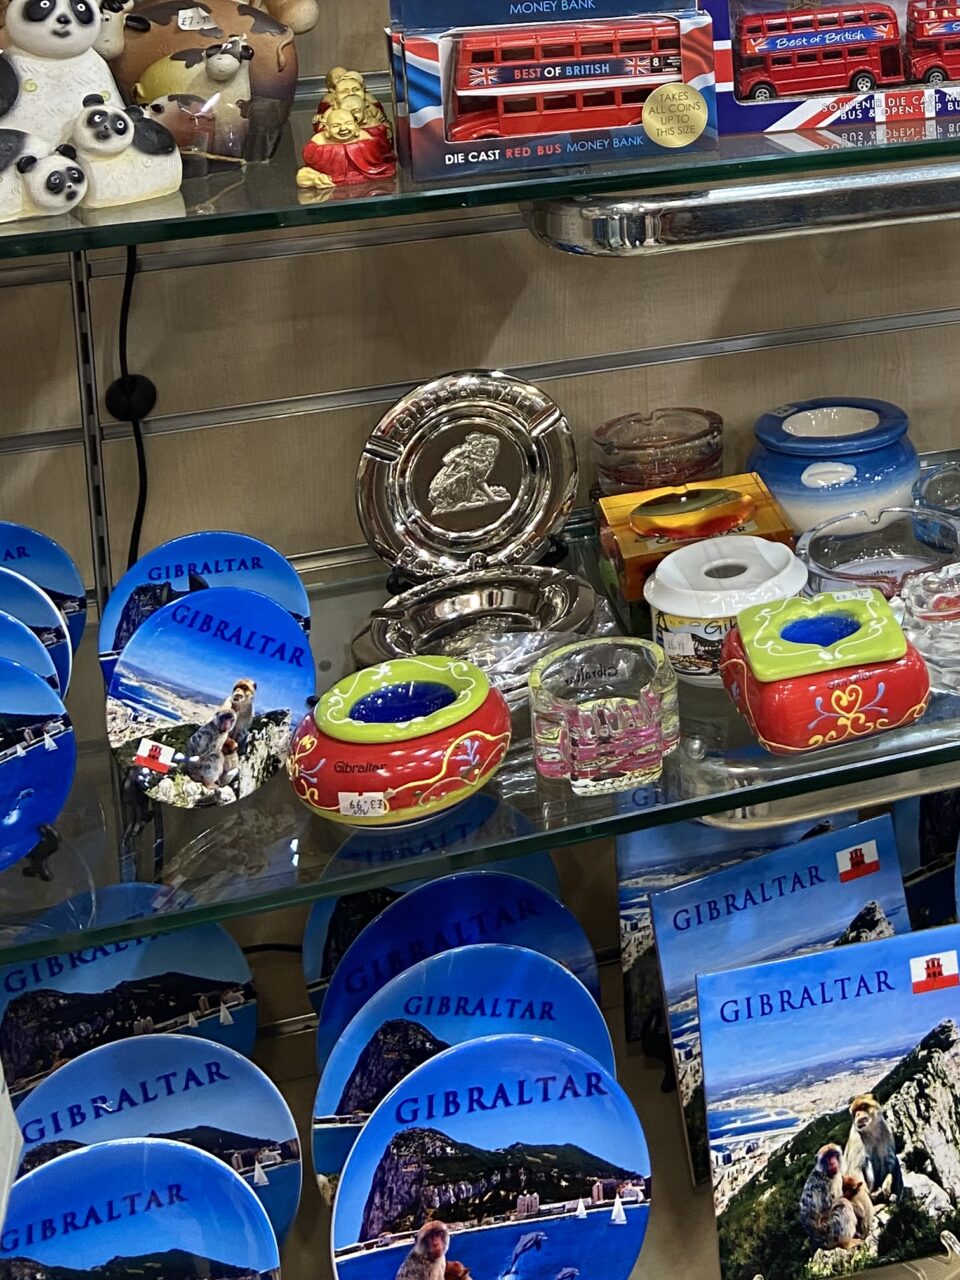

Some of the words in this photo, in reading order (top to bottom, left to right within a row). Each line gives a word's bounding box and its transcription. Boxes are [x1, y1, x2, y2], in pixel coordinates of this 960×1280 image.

[509, 0, 557, 15] MONEY
[776, 36, 808, 49] Best
[810, 35, 822, 45] of
[824, 30, 865, 43] British
[514, 68, 542, 80] BEST
[544, 66, 562, 78] OF
[565, 63, 610, 76] BRITISH
[652, 57, 660, 67] 8
[659, 91, 689, 101] TAKES
[821, 99, 883, 114] SOUVENIR
[889, 96, 907, 107] DIE
[911, 94, 940, 107] CAST
[648, 104, 666, 115] ALL
[668, 101, 701, 113] COINS
[840, 110, 863, 120] BUS
[660, 115, 675, 125] UP
[676, 113, 690, 124] TO
[656, 126, 676, 137] THIS
[677, 124, 697, 135] SIZE
[445, 153, 465, 165] DIE
[468, 150, 500, 163] CAST
[505, 146, 531, 159] RED
[537, 143, 562, 155] BUS
[566, 138, 609, 152] MONEY
[613, 135, 644, 148] BANK
[148, 556, 264, 581] GIBRALTAR
[172, 604, 305, 667] GIBRALTAR
[334, 761, 387, 774] Gibraltar
[673, 865, 826, 932] GIBRALTAR
[719, 968, 895, 1024] GIBRALTAR
[404, 996, 556, 1021] GIBRALTAR
[23, 1061, 231, 1146] GIBRALTAR
[395, 1072, 608, 1125] GIBRALTAR
[0, 1184, 189, 1254] GIBRALTAR
